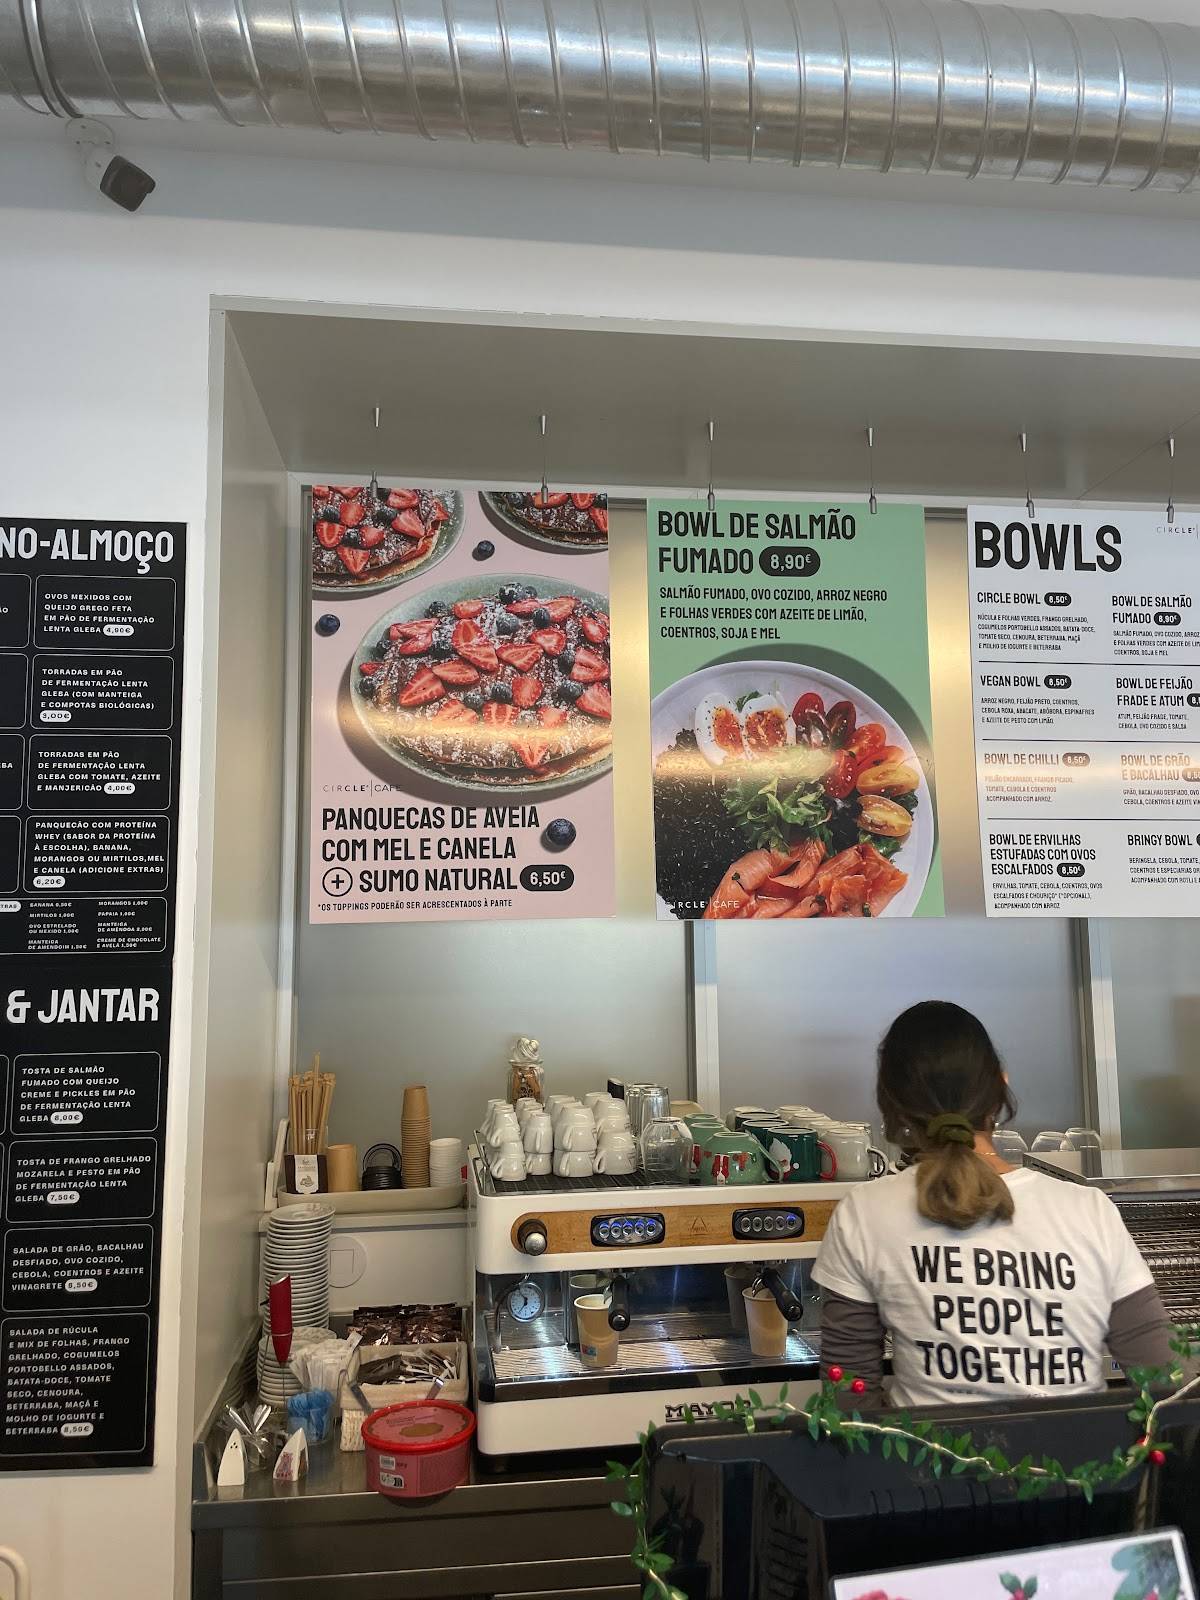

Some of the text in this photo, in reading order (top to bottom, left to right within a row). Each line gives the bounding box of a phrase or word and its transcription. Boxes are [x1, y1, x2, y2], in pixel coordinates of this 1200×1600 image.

[658, 509, 856, 540] BOWL DE SALMÃO
[975, 522, 1122, 572] BOWLS
[659, 547, 812, 574] FUMADO 8,90€
[660, 585, 887, 602] SALMÃO FUMADO, OVO COZIDO, ARROZ NEGRO
[977, 592, 1011, 604] CIRCLE
[1014, 593, 1041, 605] BOWL
[1112, 595, 1192, 608] BOWL DE SALMÃO
[60, 614, 76, 622] PÃO
[93, 615, 155, 624] FERMENTAÇÃO
[661, 607, 867, 622] E FOLHAS VERDES COM AZEITE DE LIMÃO,
[1113, 613, 1151, 624] FUMADO
[661, 627, 780, 640] COENTROS, SOJA E MEL
[106, 668, 122, 676] PÃO
[56, 679, 118, 688] FERMENTAÇÃO
[980, 676, 1011, 687] VEGAN
[1014, 676, 1041, 687] BOWL
[1116, 676, 1192, 690] BOWL DE FEIJÃO
[1117, 695, 1184, 707] FRADE E ATUM
[985, 754, 1012, 765] BOWL
[1014, 754, 1026, 765] DE
[1028, 754, 1059, 765] CHILLI
[1121, 753, 1190, 767] BOWL DE GRÃO
[53, 762, 115, 770] FERMENTAÇÃO
[1122, 769, 1179, 781] E BACALHAU
[322, 806, 539, 831] PANQUECAS DE AVEIA
[990, 834, 1081, 845] BOWL DE ERVILHAS
[1128, 835, 1192, 846] BRINGY BOWL
[322, 837, 516, 861] COM MEL E CANELA
[990, 849, 1095, 861] ESTUFADAS COM OVOS
[992, 864, 1053, 875] ESCALFADOS
[360, 870, 418, 892] SUMO
[425, 868, 517, 890] NATURAL
[530, 870, 566, 886] 6,50€
[371, 901, 404, 909] PODERÃO
[484, 898, 488, 907] À
[6, 988, 160, 1023] & JANTAR
[119, 1088, 135, 1096] PÃO
[35, 1102, 100, 1110] FERMENTAÇÃO
[67, 1244, 94, 1253] GRÃO,
[97, 1243, 144, 1251] BACALHAU
[13, 1258, 61, 1266] DESFIADO,
[911, 1246, 1075, 1290] WE BRING
[933, 1295, 1063, 1336] PEOPLE
[915, 1340, 1086, 1385] TOGETHER
